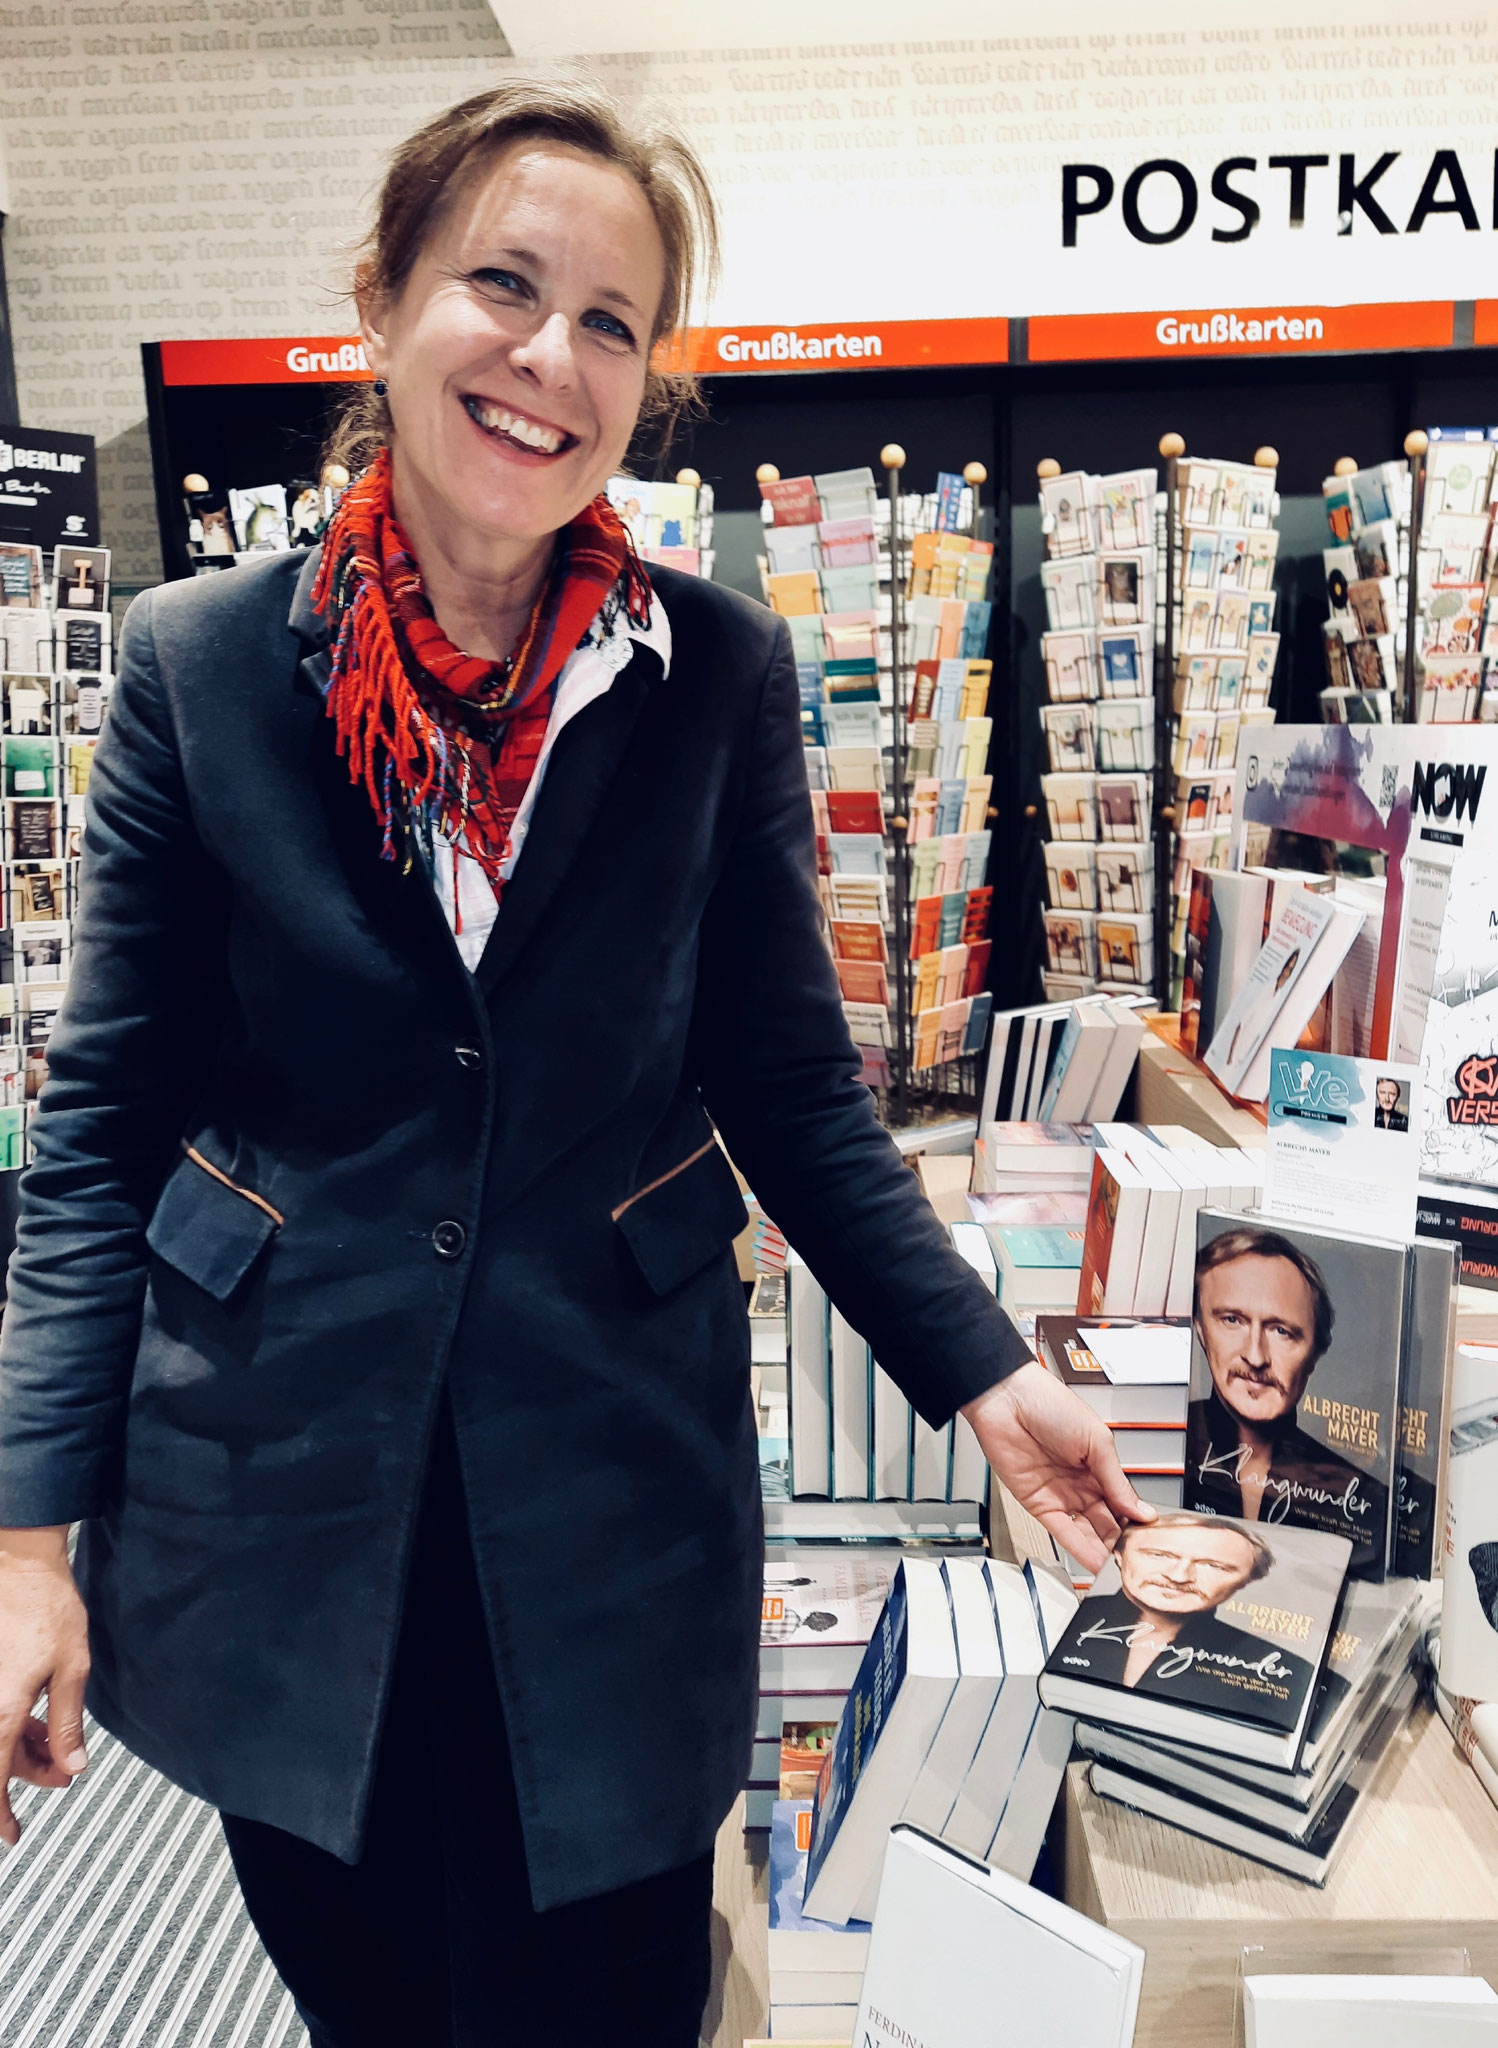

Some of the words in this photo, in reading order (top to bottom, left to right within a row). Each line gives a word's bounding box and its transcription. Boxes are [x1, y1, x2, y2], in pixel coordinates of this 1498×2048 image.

[1062, 149, 1498, 247] POSTKA
[1156, 314, 1323, 345] Grußkarten
[718, 332, 882, 361] Grußkarten
[14, 448, 82, 474] BERLIN
[1410, 760, 1487, 823] NOW
[1303, 1394, 1380, 1431] ALBRECHT
[1328, 1419, 1378, 1449] MAYER
[1198, 1441, 1372, 1525] Klangwunder
[1225, 1599, 1315, 1631] ALBRECHT
[1250, 1615, 1311, 1641] MAYER
[868, 2005, 927, 2048] FERDIN
